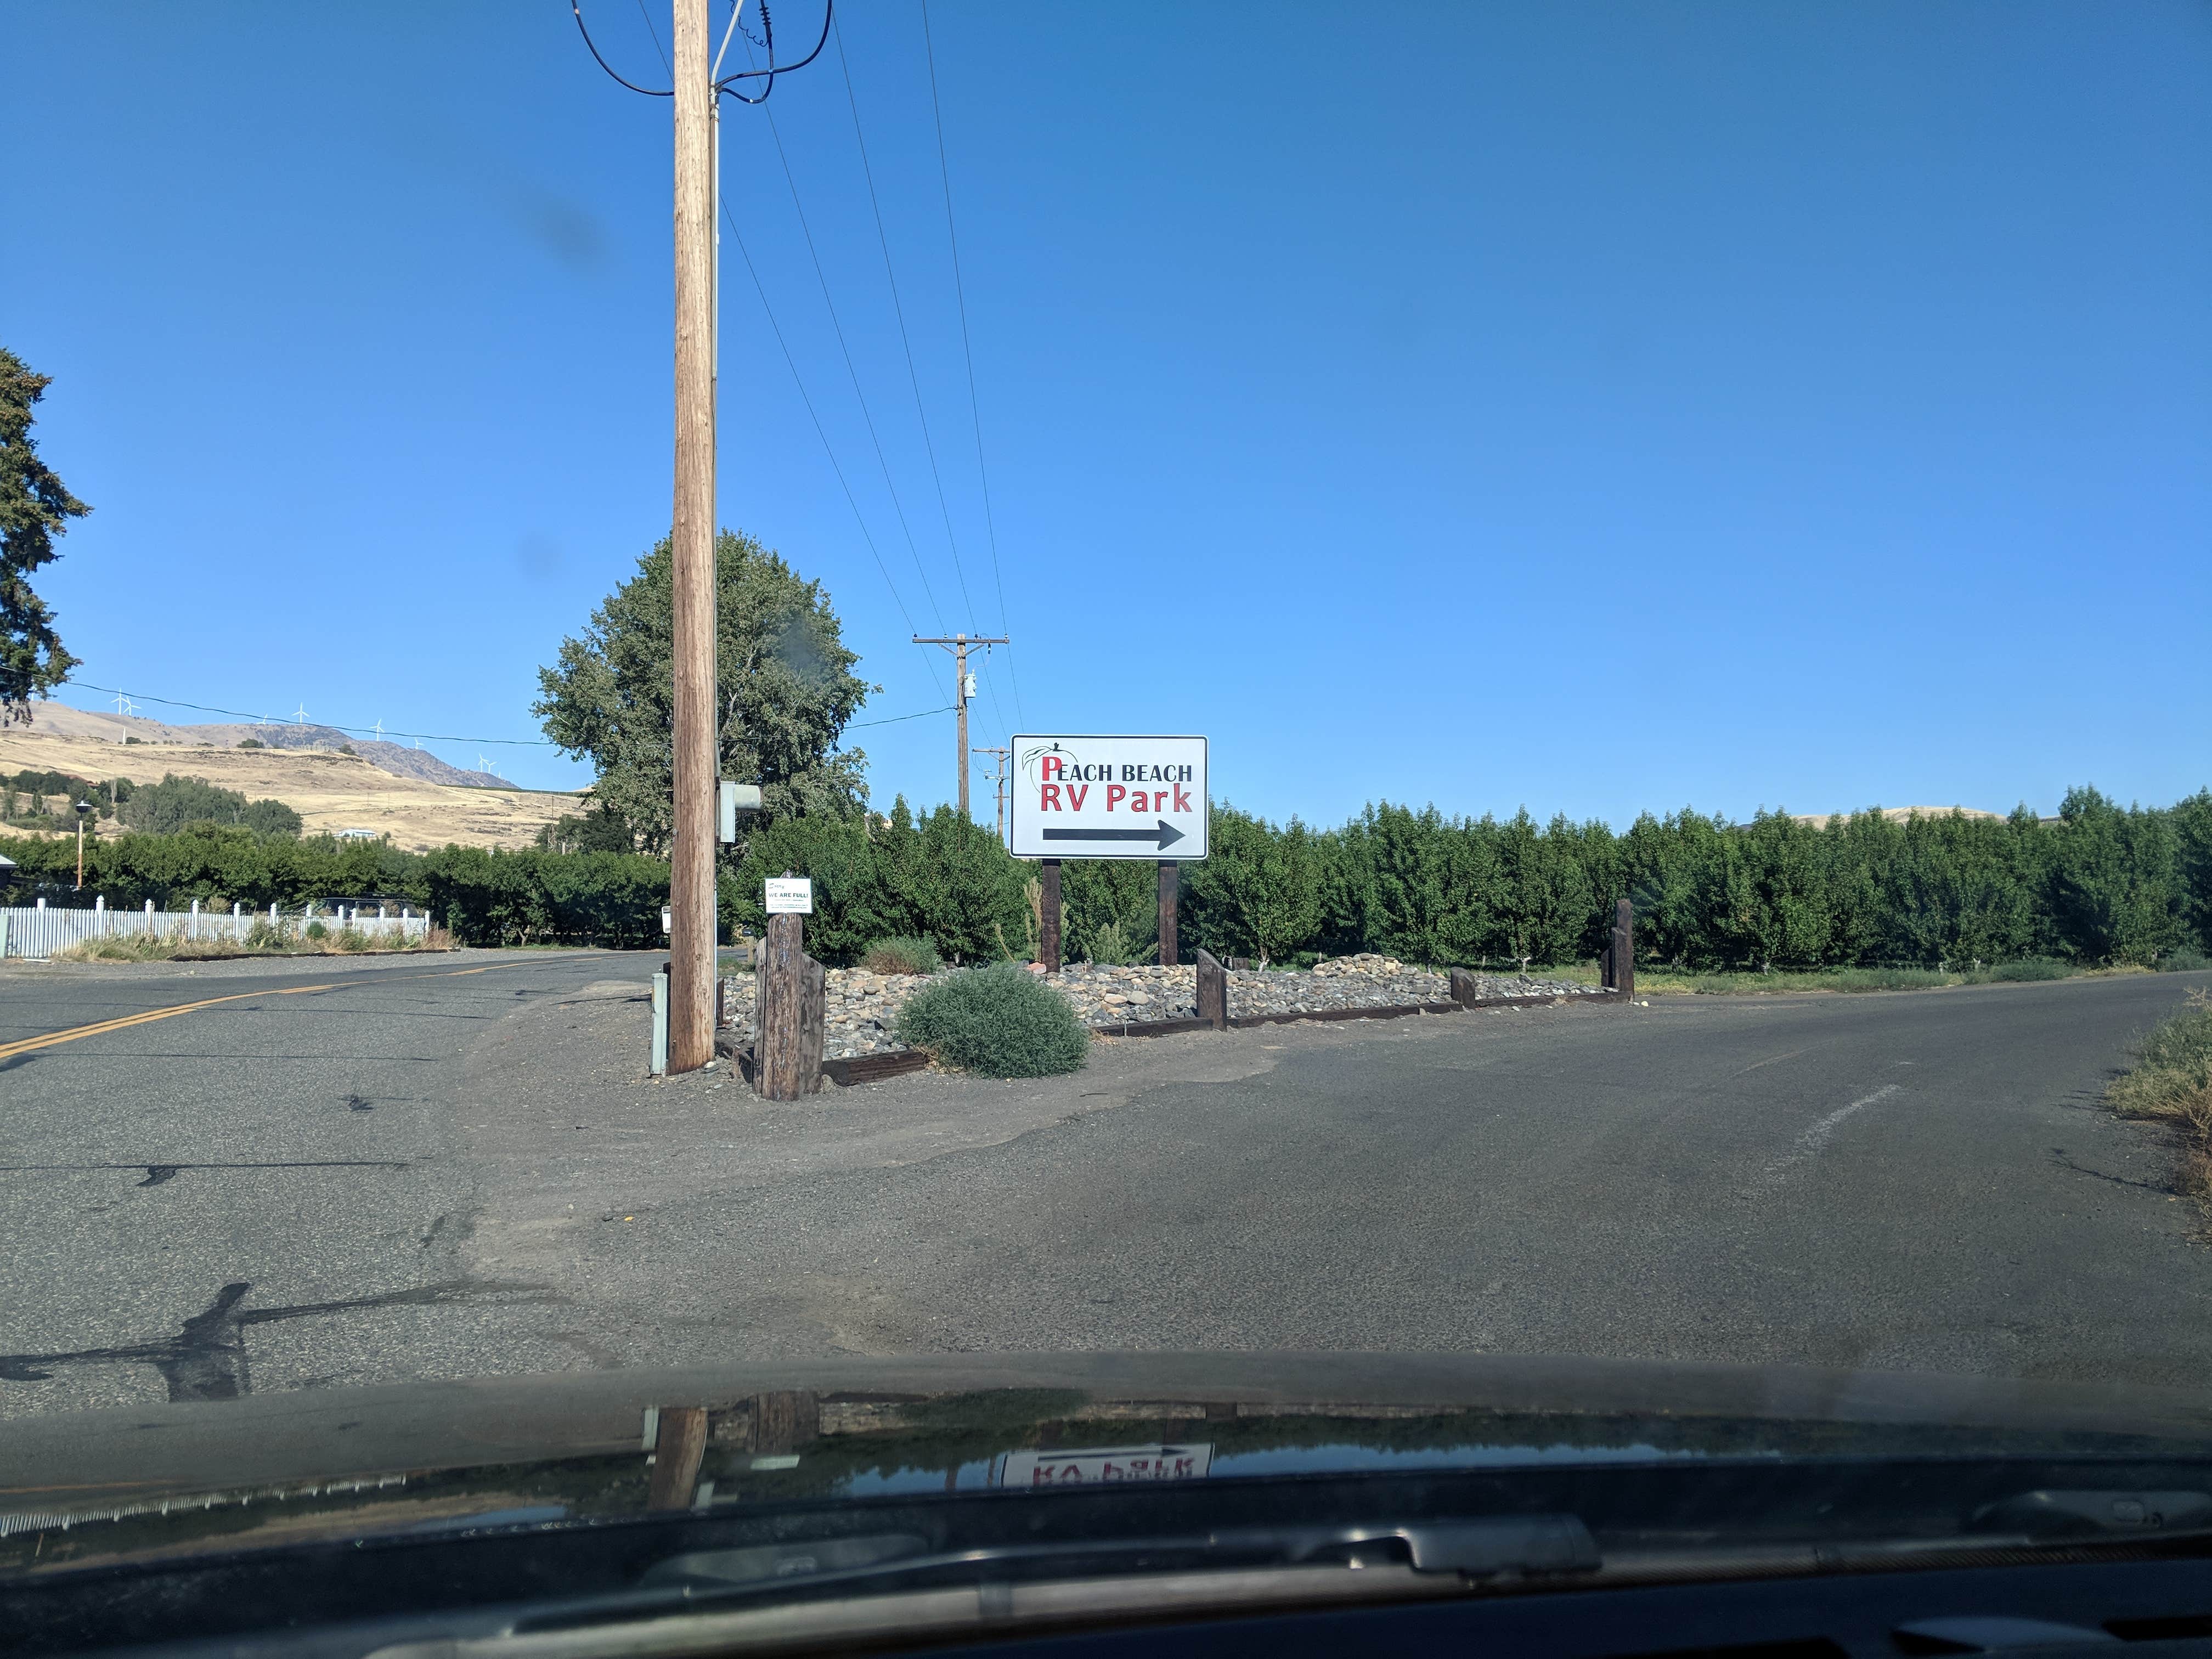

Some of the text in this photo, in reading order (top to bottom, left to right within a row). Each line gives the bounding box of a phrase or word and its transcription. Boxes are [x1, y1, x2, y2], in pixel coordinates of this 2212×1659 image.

[1042, 757, 1192, 782] PEACH BEACH
[1041, 783, 1192, 812] RV Park
